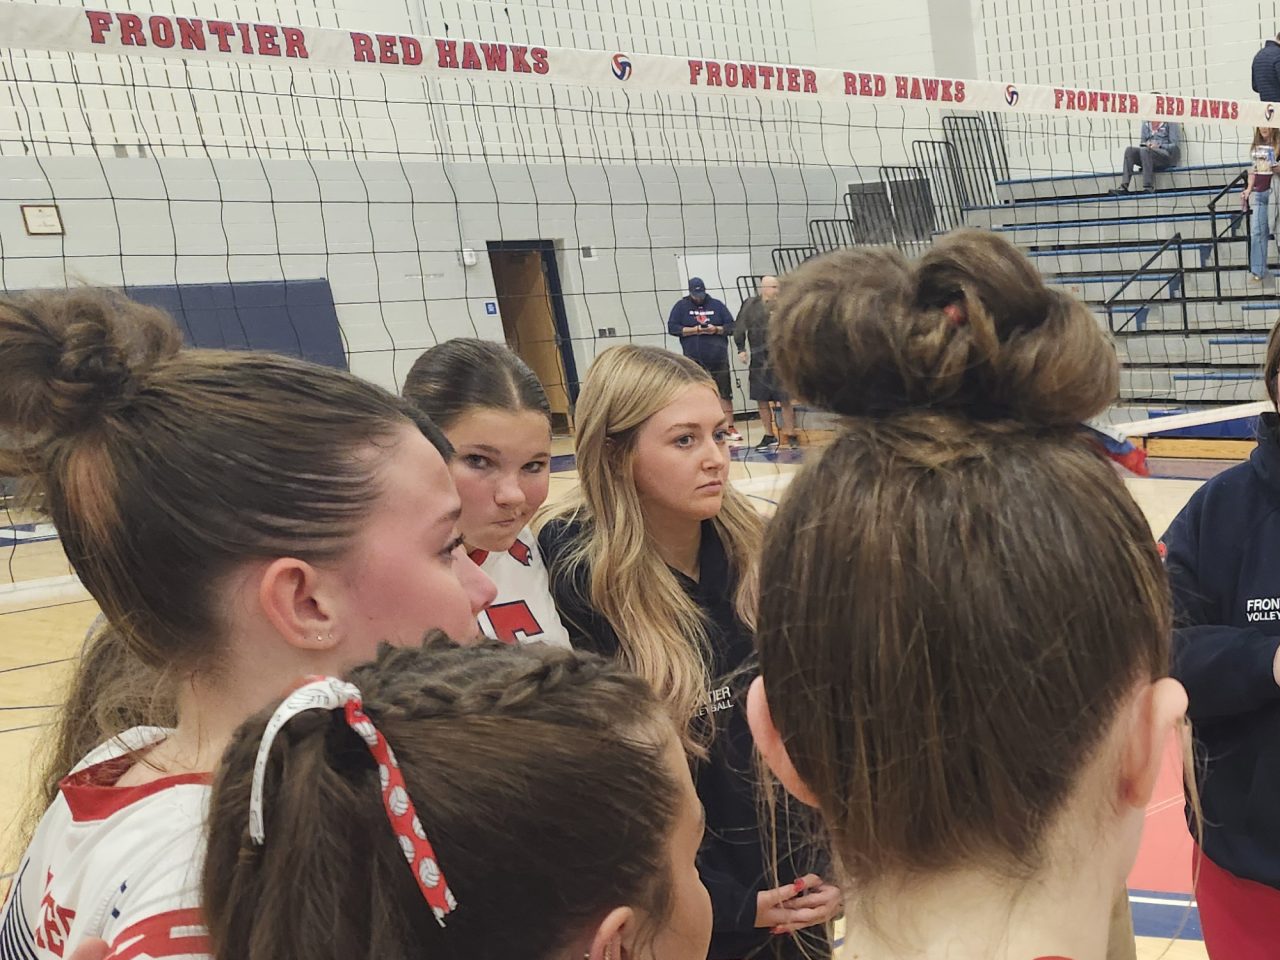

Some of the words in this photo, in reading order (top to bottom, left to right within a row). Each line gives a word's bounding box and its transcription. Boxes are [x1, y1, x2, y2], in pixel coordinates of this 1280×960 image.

[85, 10, 309, 59] FRONTIER
[350, 31, 424, 66] RED
[435, 39, 550, 75] HAWKS
[688, 60, 818, 94] FRONTIER
[843, 71, 886, 98] RED
[895, 75, 966, 103] HAWKS
[1054, 88, 1139, 114] FRONTIER
[1155, 95, 1185, 116] RED
[1190, 98, 1239, 120] HAWKS
